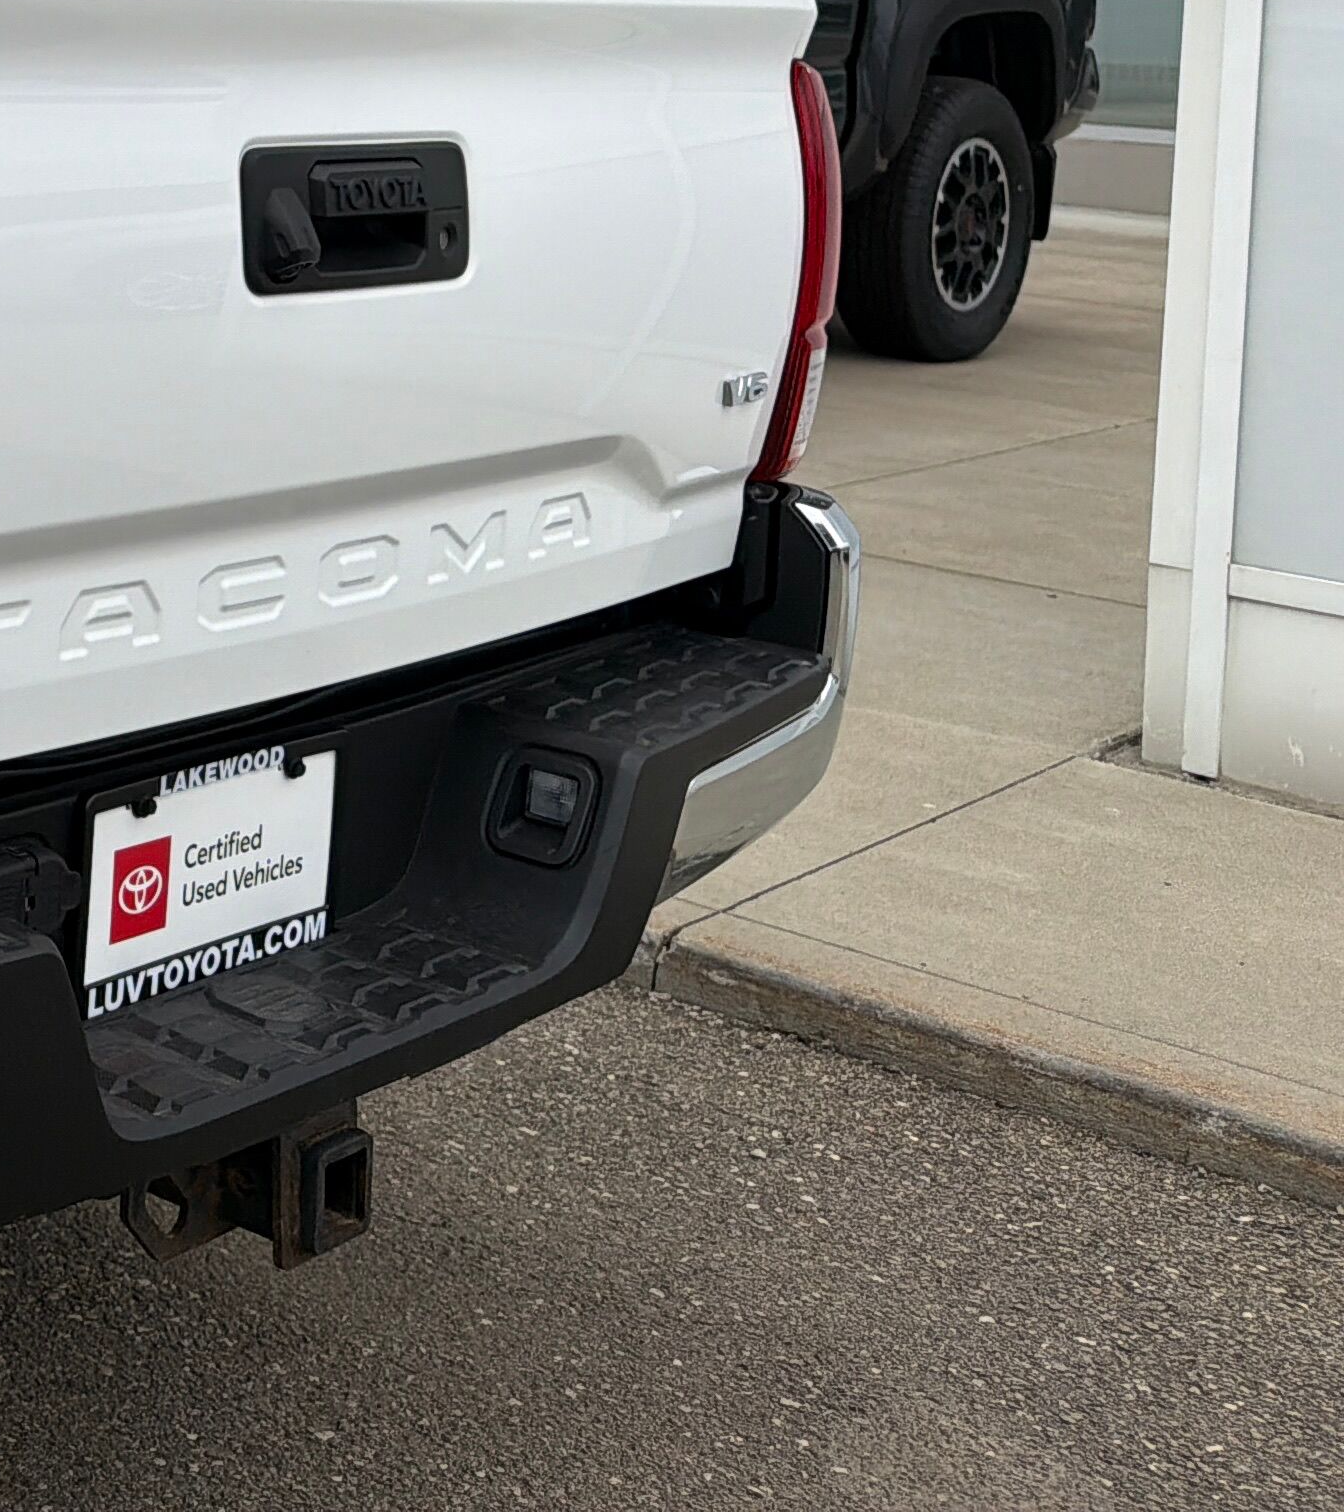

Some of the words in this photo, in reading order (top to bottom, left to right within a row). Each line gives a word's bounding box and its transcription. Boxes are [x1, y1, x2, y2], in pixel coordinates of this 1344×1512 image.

[328, 176, 428, 212] TOYOTA
[721, 371, 769, 407] V6
[160, 745, 286, 796] LAKEWOOD
[184, 824, 263, 868] Certified
[182, 867, 227, 906] Used
[232, 854, 304, 892] Vehicles
[88, 911, 326, 1019] LUVTOYOTA.COM
